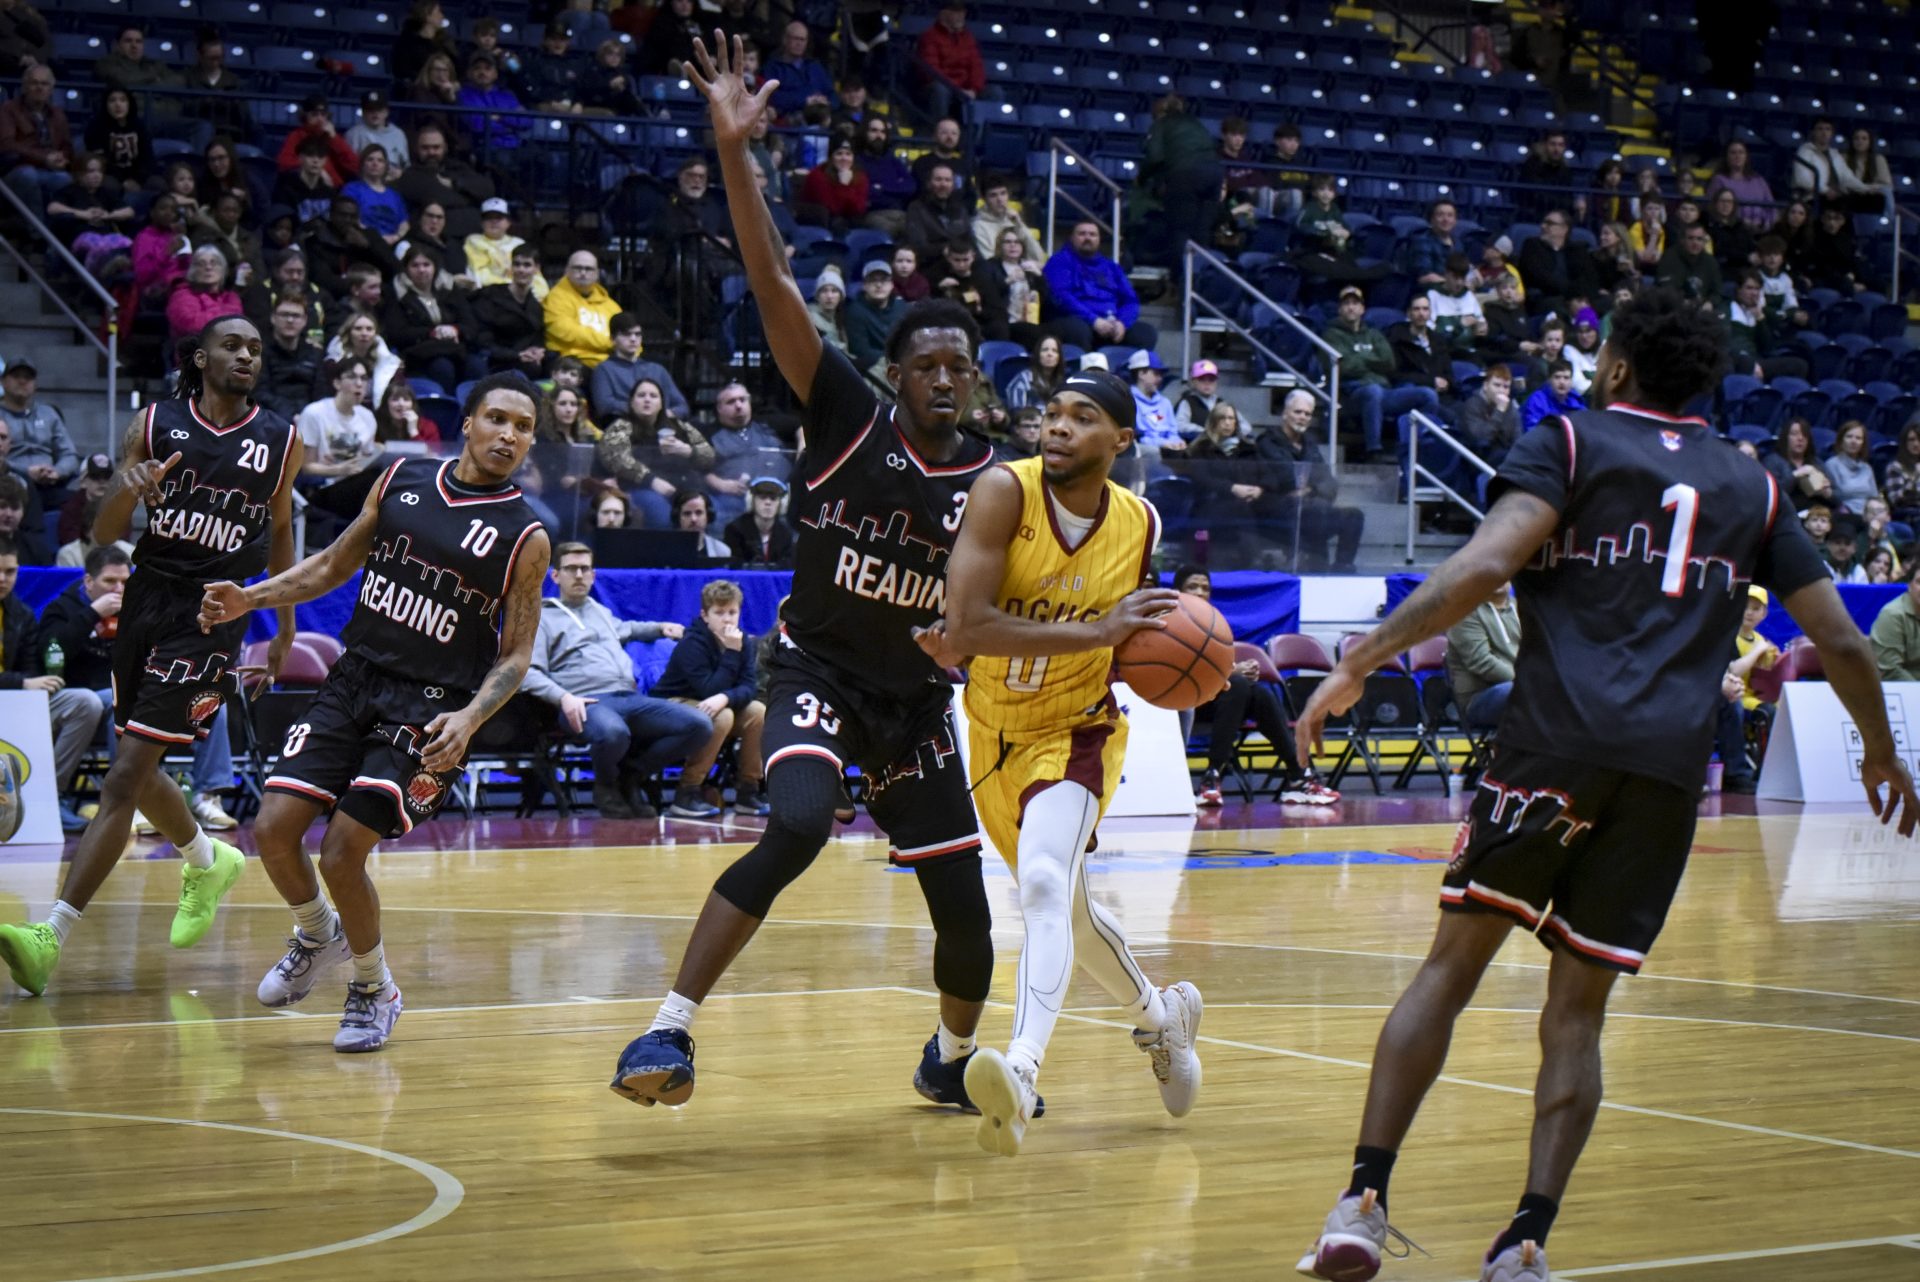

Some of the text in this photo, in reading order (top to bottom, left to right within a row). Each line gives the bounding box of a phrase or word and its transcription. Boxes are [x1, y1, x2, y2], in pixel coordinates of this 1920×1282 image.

[237, 438, 270, 473] 20
[150, 508, 247, 553] READING
[460, 518, 499, 558] 10
[1661, 482, 1699, 597] 1
[360, 569, 459, 643] READING
[834, 545, 949, 616] READIN
